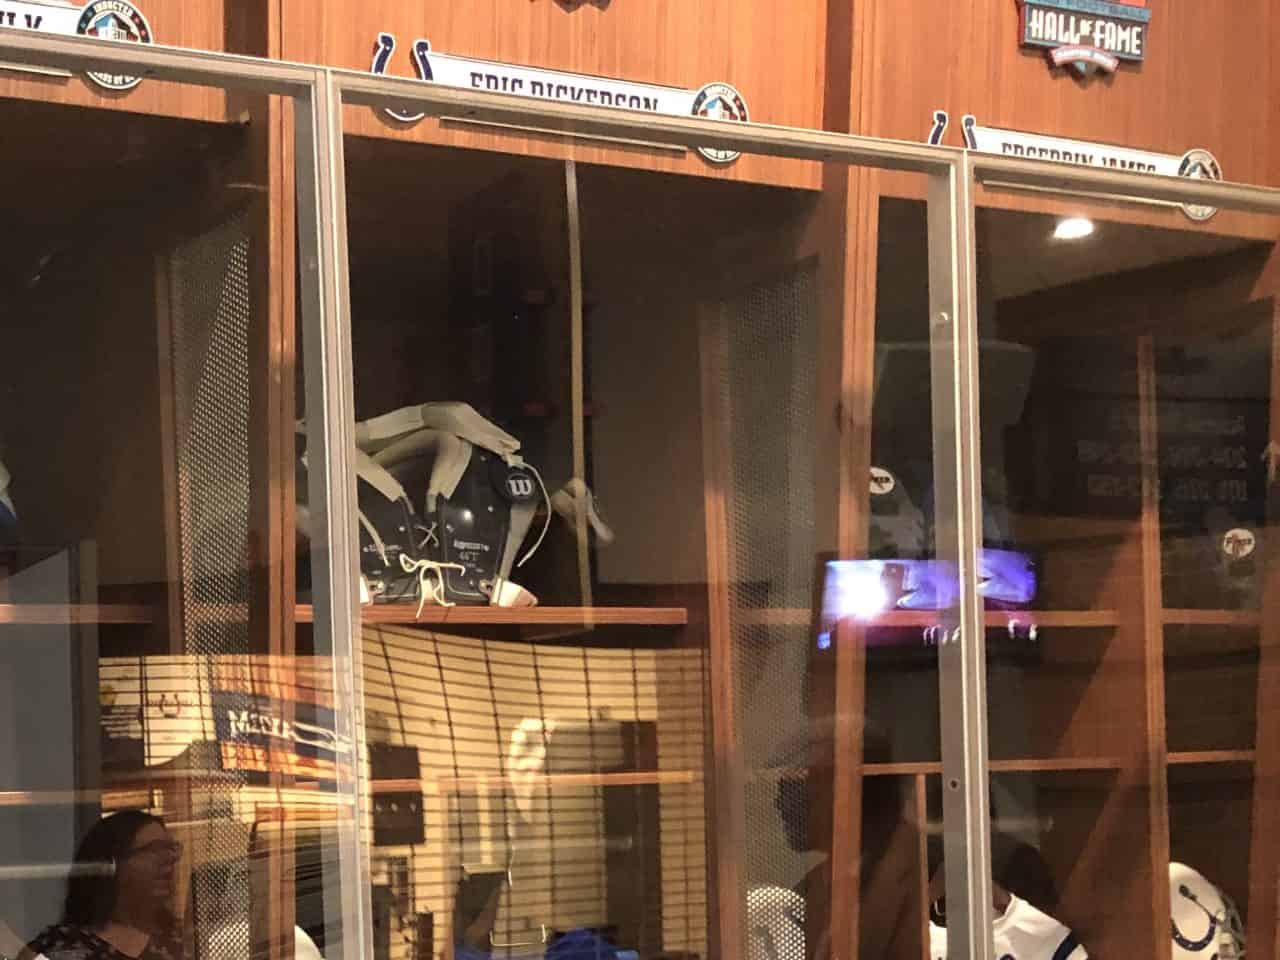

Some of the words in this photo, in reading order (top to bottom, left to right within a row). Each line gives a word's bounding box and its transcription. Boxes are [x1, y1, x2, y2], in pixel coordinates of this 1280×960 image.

[1029, 8, 1080, 45] HALL
[1080, 18, 1094, 37] OF
[1093, 19, 1142, 55] FAME
